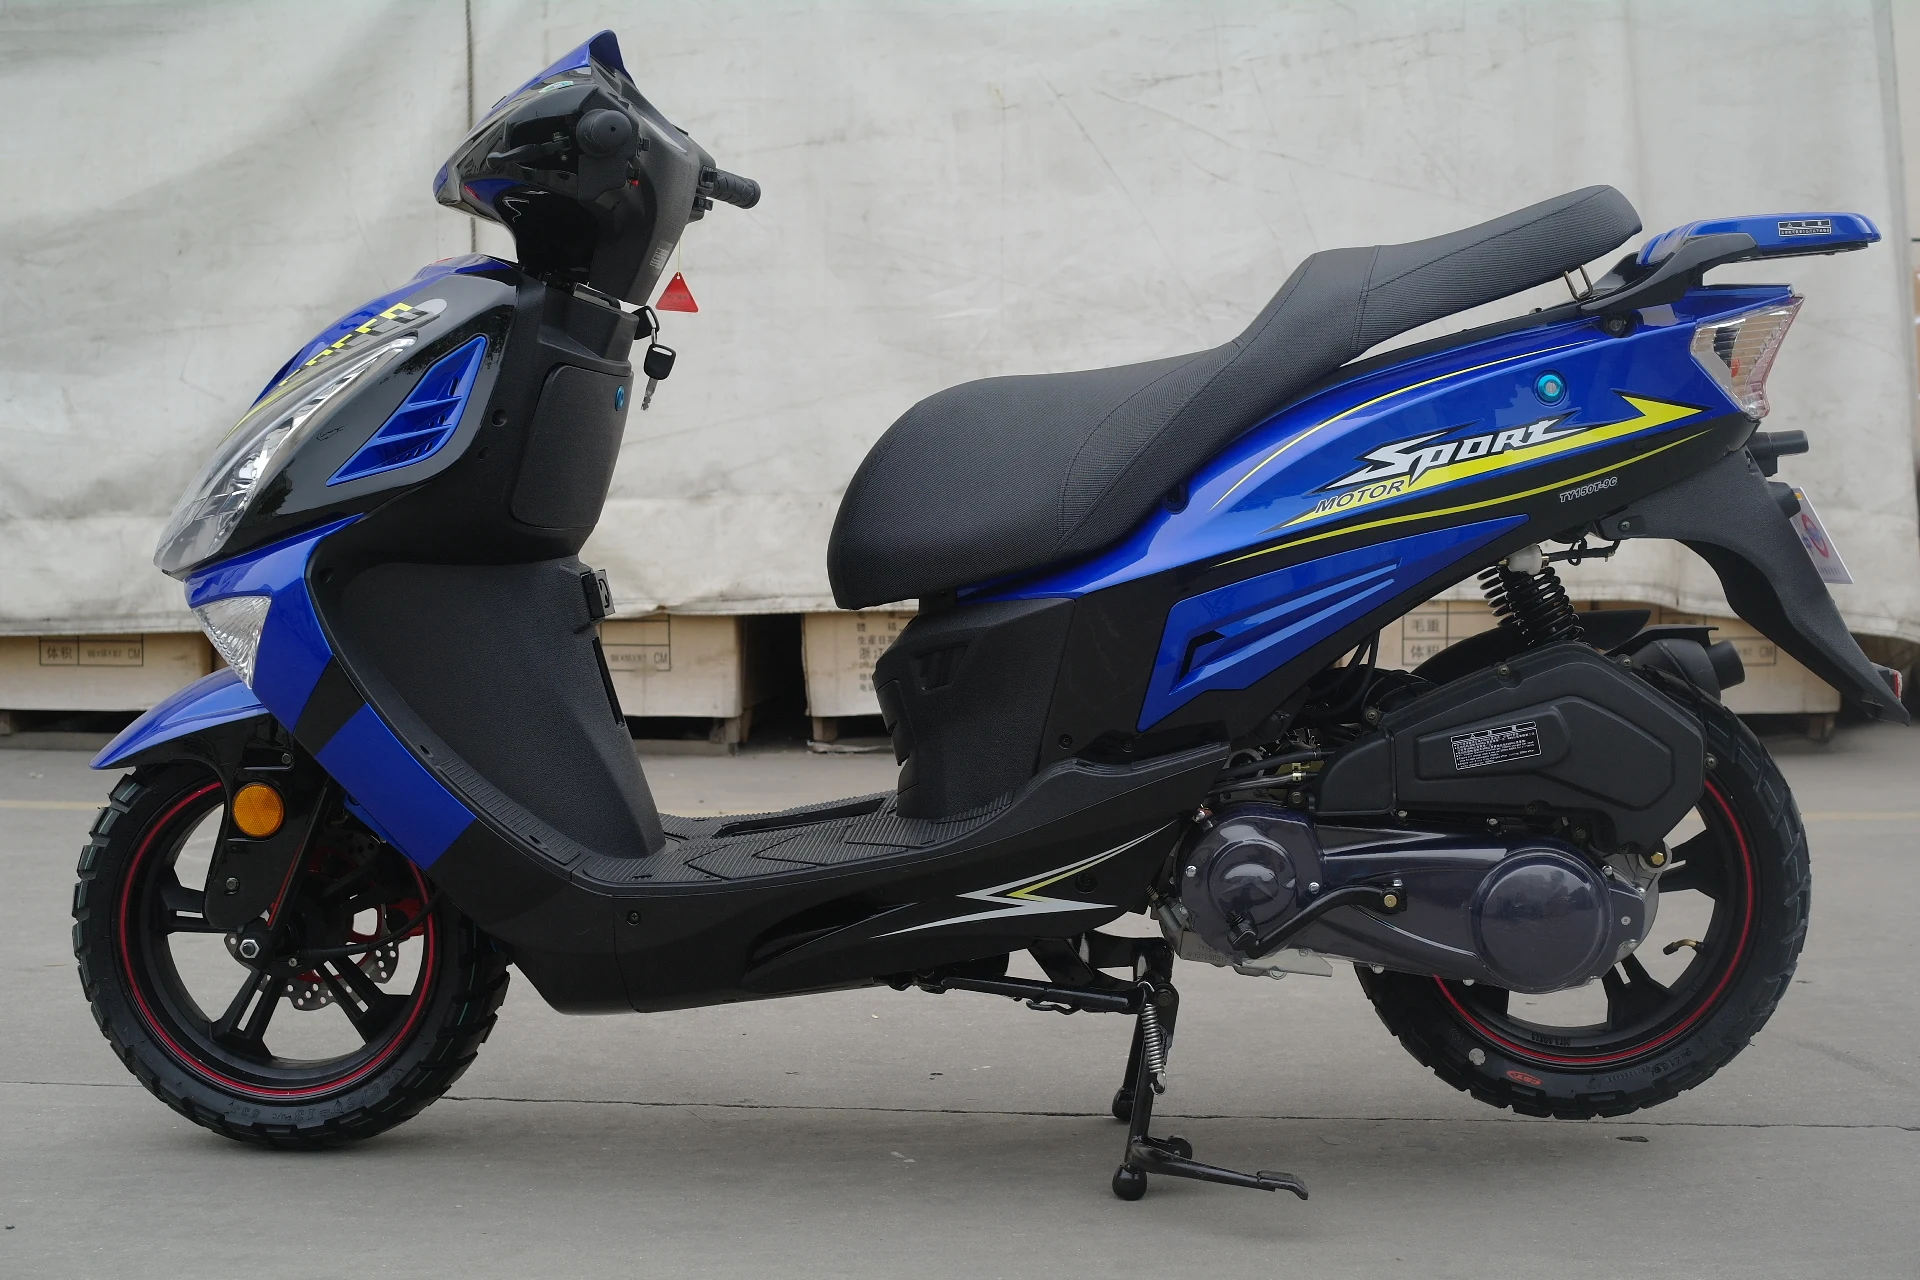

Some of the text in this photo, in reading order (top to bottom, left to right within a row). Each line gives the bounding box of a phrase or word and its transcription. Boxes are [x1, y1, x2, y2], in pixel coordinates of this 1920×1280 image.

[1314, 479, 1405, 514] MOTOR
[1559, 476, 1618, 503] TY150T-9C
[653, 651, 668, 664] CM
